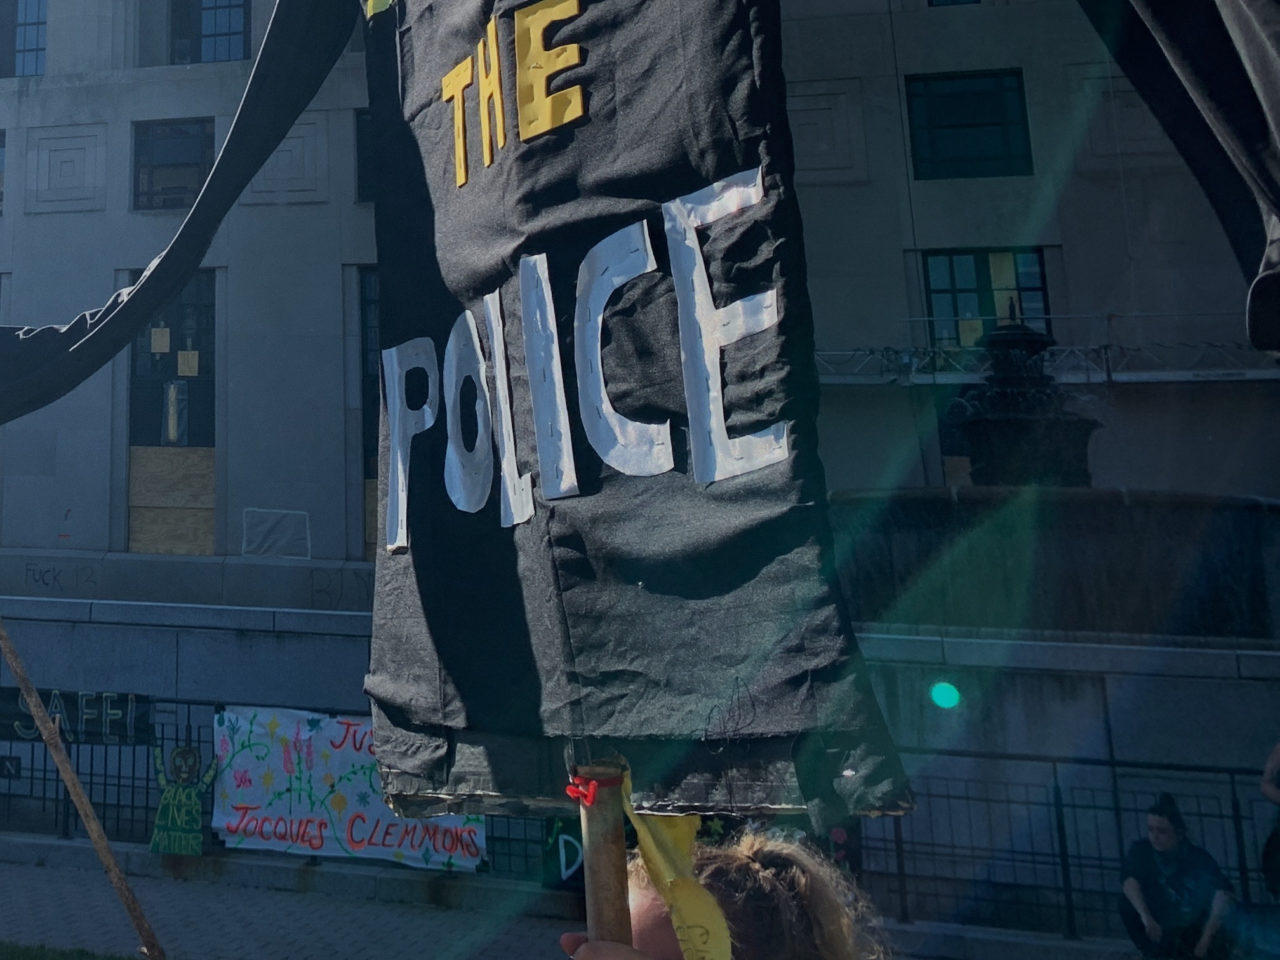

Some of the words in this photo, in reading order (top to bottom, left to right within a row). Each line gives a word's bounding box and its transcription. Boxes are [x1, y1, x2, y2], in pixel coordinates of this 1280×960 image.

[381, 164, 790, 555] POLICE
[23, 562, 64, 591] FUCK
[160, 785, 201, 806] BLACK
[155, 803, 202, 830] LIVES
[346, 812, 480, 858] CLEMMONS
